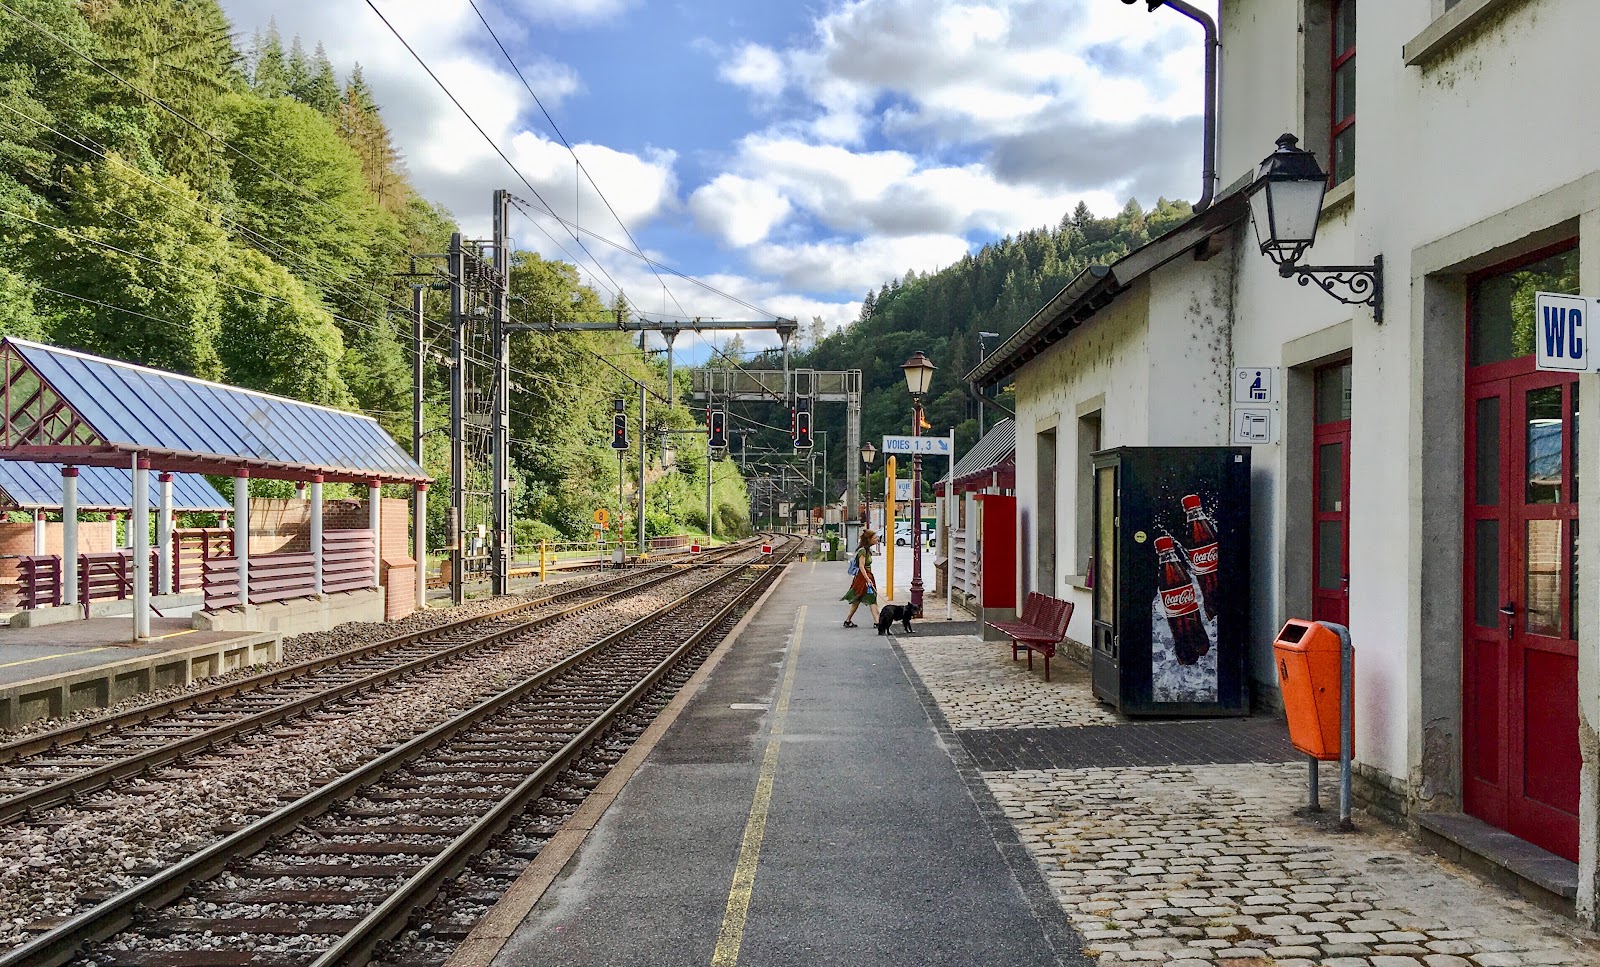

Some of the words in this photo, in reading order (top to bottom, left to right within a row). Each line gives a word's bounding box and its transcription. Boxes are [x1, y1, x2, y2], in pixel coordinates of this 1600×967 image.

[1543, 306, 1583, 359] WC
[887, 440, 910, 450] VOIES
[1164, 588, 1194, 608] Coca-Cola
